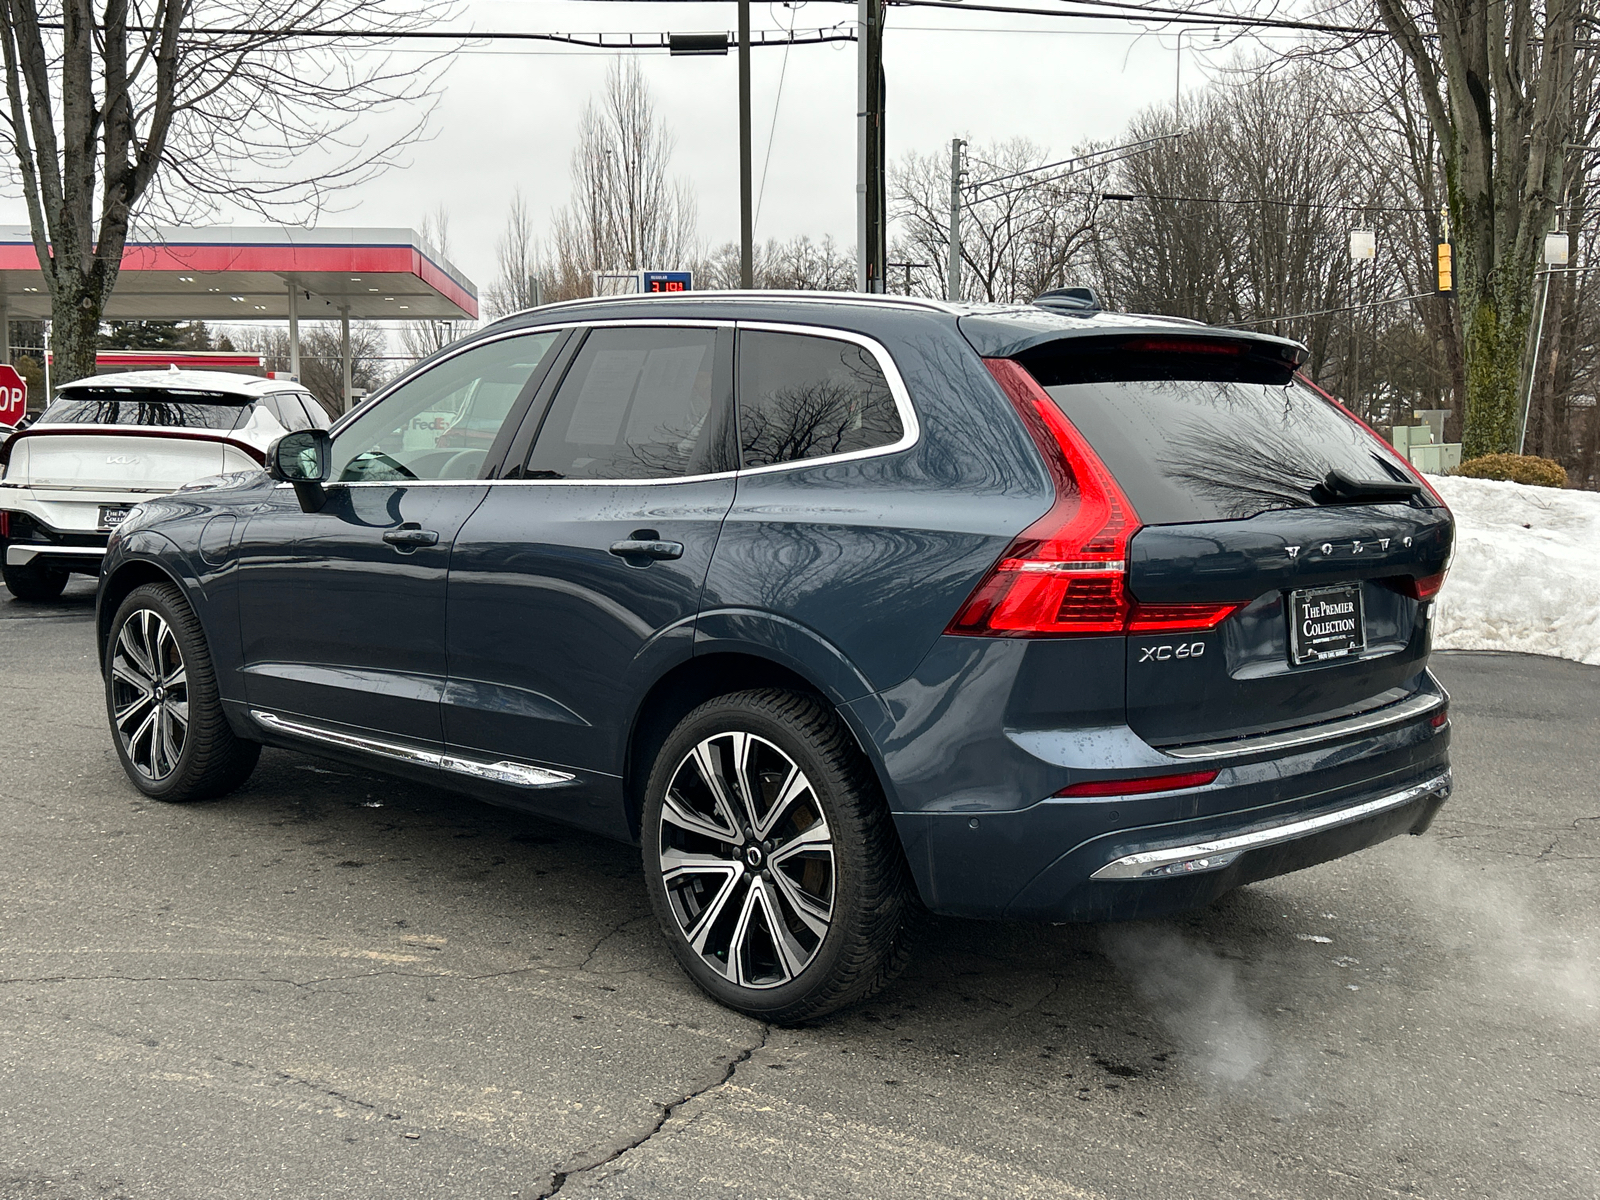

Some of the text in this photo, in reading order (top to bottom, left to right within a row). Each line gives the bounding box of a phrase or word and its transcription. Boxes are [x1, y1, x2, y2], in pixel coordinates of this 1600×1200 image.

[1284, 536, 1412, 558] VOLVO
[1302, 601, 1355, 619] THE PREMIER
[1303, 618, 1355, 637] COLLECTION
[1138, 642, 1205, 662] XC60
